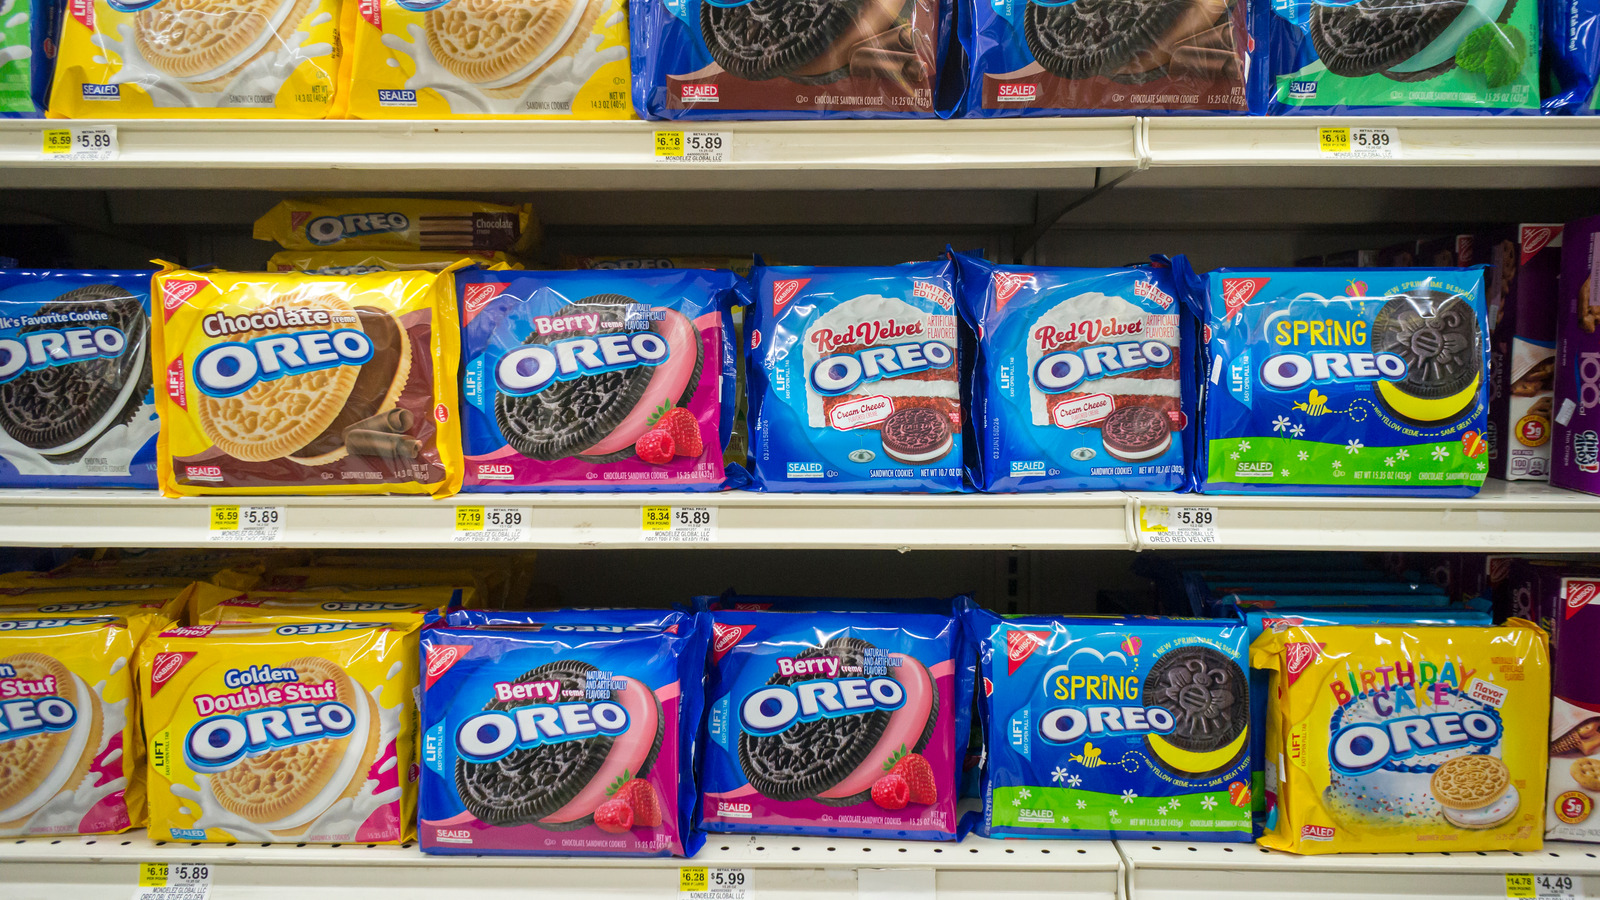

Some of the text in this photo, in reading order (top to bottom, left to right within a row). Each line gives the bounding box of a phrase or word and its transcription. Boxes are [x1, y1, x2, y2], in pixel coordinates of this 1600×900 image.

[83, 84, 119, 96] SEALED
[380, 90, 415, 101] SEALED
[683, 85, 717, 96] SEALED
[999, 85, 1036, 96] SEALED
[526, 101, 569, 110] SANDWICH COOKIES
[591, 101, 601, 109] 14.3
[815, 95, 883, 105] CHOCOLATE SANDWICH COOKIES
[1130, 94, 1199, 104] CHOCOLATE SANDWICH COOKIES
[1207, 95, 1220, 104] 15.25
[77, 134, 110, 148] $5.89
[687, 137, 722, 149] $5.89
[1353, 133, 1389, 146] $5.89
[309, 213, 406, 242] OREO
[476, 218, 513, 230] Chocolate
[167, 284, 195, 307] NABISCO
[467, 285, 494, 311] NABISCO
[775, 281, 797, 304] NABISCO
[914, 281, 954, 305] LIMITED
[1134, 279, 1173, 304] LIMITED
[1134, 288, 1169, 310] EDITION
[1228, 281, 1253, 306] NABISCO
[913, 289, 951, 311] EDITION
[21, 310, 108, 326] Favorite Cookie
[203, 309, 356, 336] Chocolate creme
[535, 313, 623, 335] Berry creme
[624, 320, 649, 330] FLAVORED
[1145, 314, 1180, 327] ARTIFICIALLY
[811, 319, 924, 353] Red Velvet
[927, 328, 955, 339] FLAVORED
[1034, 317, 1143, 350] Red Velvet
[1145, 327, 1175, 338] FLAVORED
[199, 331, 370, 389] OREO
[498, 336, 667, 389] OREO
[813, 342, 953, 391] OREO
[1036, 341, 1171, 388] OREO
[1001, 365, 1010, 389] LIFT
[1232, 364, 1242, 392] LIFT
[1263, 352, 1406, 388] OREO
[169, 369, 179, 397] LIFT
[466, 369, 476, 396] LIFT
[776, 367, 785, 391] LIFT
[836, 408, 859, 420] Cream
[860, 400, 886, 413] Cheese
[1059, 399, 1107, 418] Cream Cheese
[1381, 414, 1420, 438] YELLOW CREME
[1440, 417, 1472, 437] SAME GREAT
[1527, 422, 1542, 437] 5g
[187, 466, 221, 477] SEALED
[478, 464, 512, 475] SEALED
[788, 463, 822, 472] SEALED
[870, 469, 929, 478] SANDWICH COOKIES NET
[1012, 461, 1045, 471] SEALED
[1090, 467, 1133, 476] SANDWICH COOKIES
[1237, 462, 1273, 472] SEALED
[604, 471, 669, 480] CHOCOLATE SANDWICH COOKIES
[1354, 471, 1386, 480] NET 15.35
[1419, 472, 1443, 481] CHOCOLATE
[216, 512, 238, 520] $6.59
[244, 510, 279, 523] $5.89
[458, 513, 481, 521] $7.19
[487, 512, 522, 525] $5.89
[647, 512, 669, 521] $8.34
[676, 511, 710, 524] $5.89
[1177, 511, 1212, 524] $5.89
[1569, 584, 1595, 607] NABISCO
[715, 627, 740, 650] NABISCO
[1157, 637, 1213, 656] NEW SPRINGTIME
[864, 648, 890, 657] NATURALLY
[154, 655, 181, 682] NABISCO
[429, 649, 455, 675] NABISCO
[777, 656, 838, 677] Berry
[225, 665, 297, 688] Golden
[586, 671, 612, 680] NATURALLY
[863, 666, 887, 676] FLAVORED
[2, 676, 55, 697] Stuf
[1330, 660, 1477, 706] BIRTHDAY
[1475, 682, 1505, 700] flavor
[195, 680, 335, 716] Double Stuf
[495, 681, 585, 702] Berry creme
[585, 690, 610, 699] FLAVORED
[1373, 682, 1450, 717] CAKE
[1472, 690, 1502, 706] creme
[743, 678, 903, 729] OREO
[459, 702, 626, 756] OREO
[711, 708, 721, 734] LIFT
[1041, 706, 1174, 743] OREO
[192, 702, 352, 759] OREO
[1012, 718, 1023, 746] LIFT
[1292, 733, 1301, 759] LIFT
[1334, 712, 1498, 767] OREO
[155, 740, 165, 767] LIFT
[427, 736, 436, 762] LIFT
[1152, 765, 1172, 783] YELLOW
[1208, 769, 1239, 787] SAME GREAT
[718, 802, 751, 812] SEALED
[1019, 809, 1054, 819] SEALED
[1567, 799, 1582, 813] 5g
[838, 815, 902, 824] CHOCOLATE SANDWICH COOKIES
[1130, 819, 1139, 827] NET
[436, 829, 471, 839] SEALED
[561, 838, 627, 848] CHOCOLATE SANDWICH COOKIES
[147, 867, 169, 876] $6.18
[175, 866, 209, 879] $5.89
[682, 873, 705, 882] $6.28
[711, 872, 745, 885] $5.99
[1536, 876, 1573, 890] $4.49
